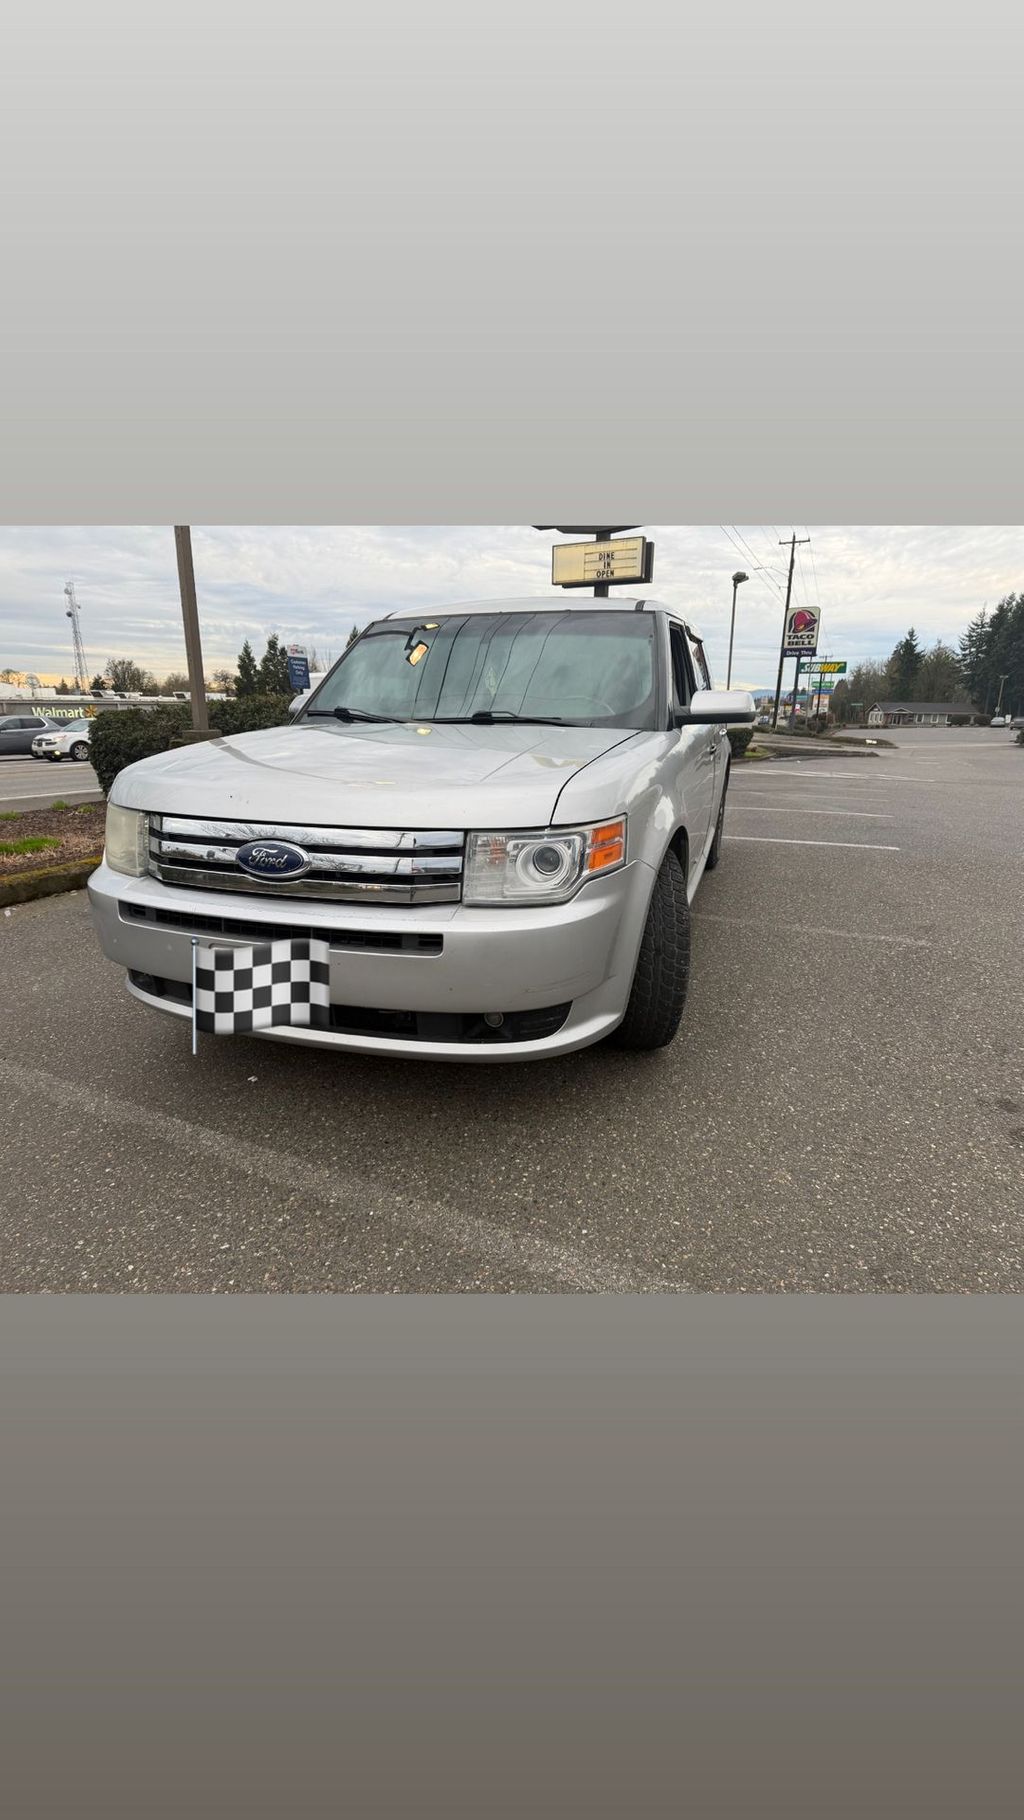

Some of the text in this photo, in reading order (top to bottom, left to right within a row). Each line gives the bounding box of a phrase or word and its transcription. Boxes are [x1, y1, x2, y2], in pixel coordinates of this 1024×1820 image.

[599, 552, 615, 561] DINE
[596, 570, 615, 578] OPEN
[801, 663, 841, 673] SUBWAY
[31, 707, 85, 718] Walmart
[248, 847, 288, 868] Ford
